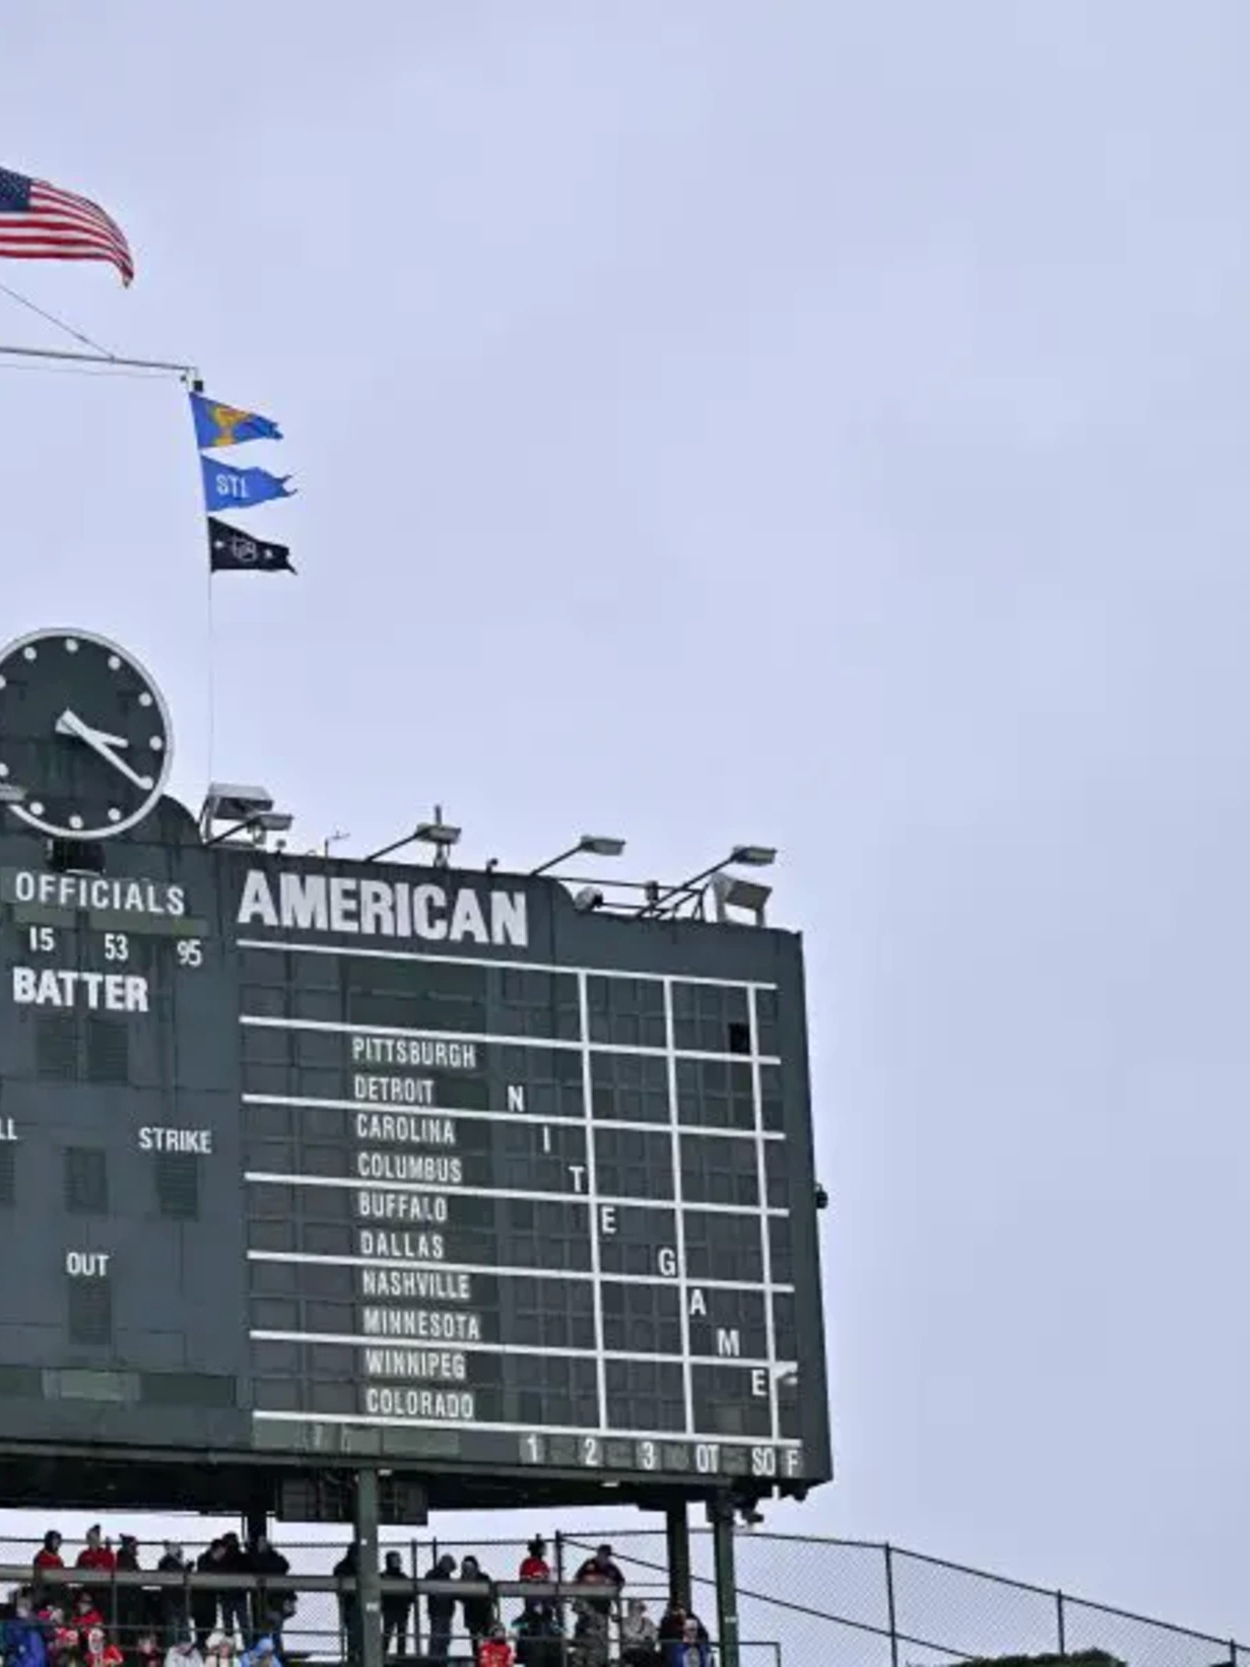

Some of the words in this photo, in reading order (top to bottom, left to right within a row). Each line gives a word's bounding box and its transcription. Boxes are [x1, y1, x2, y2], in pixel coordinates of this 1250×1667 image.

[215, 473, 250, 498] STL
[15, 871, 185, 916] OFFICIALS
[236, 866, 530, 950] AMERICAN
[29, 926, 55, 952] 15
[104, 933, 129, 961] 53
[176, 939, 203, 967] 95
[13, 966, 149, 1012] BATTER
[352, 1034, 478, 1068] PITTSBURGH
[352, 1074, 436, 1107] DETROIT
[138, 1126, 212, 1154] STRIKE
[356, 1112, 458, 1144] CAROLINA
[356, 1154, 464, 1186] COLUMBUS
[358, 1191, 447, 1223] BUFFALO
[360, 1230, 444, 1260] DALLAS
[66, 1251, 110, 1277] OUT
[362, 1269, 470, 1299] NASHVILLE
[362, 1307, 482, 1342] MINNESOTA
[365, 1349, 466, 1380] WINNIPEG
[366, 1388, 474, 1419] COLORADO
[526, 1434, 538, 1463] 1
[584, 1437, 599, 1466] 2
[641, 1441, 655, 1470] 3
[695, 1444, 720, 1473] OT
[751, 1446, 776, 1477] SO
[786, 1449, 799, 1477] F
